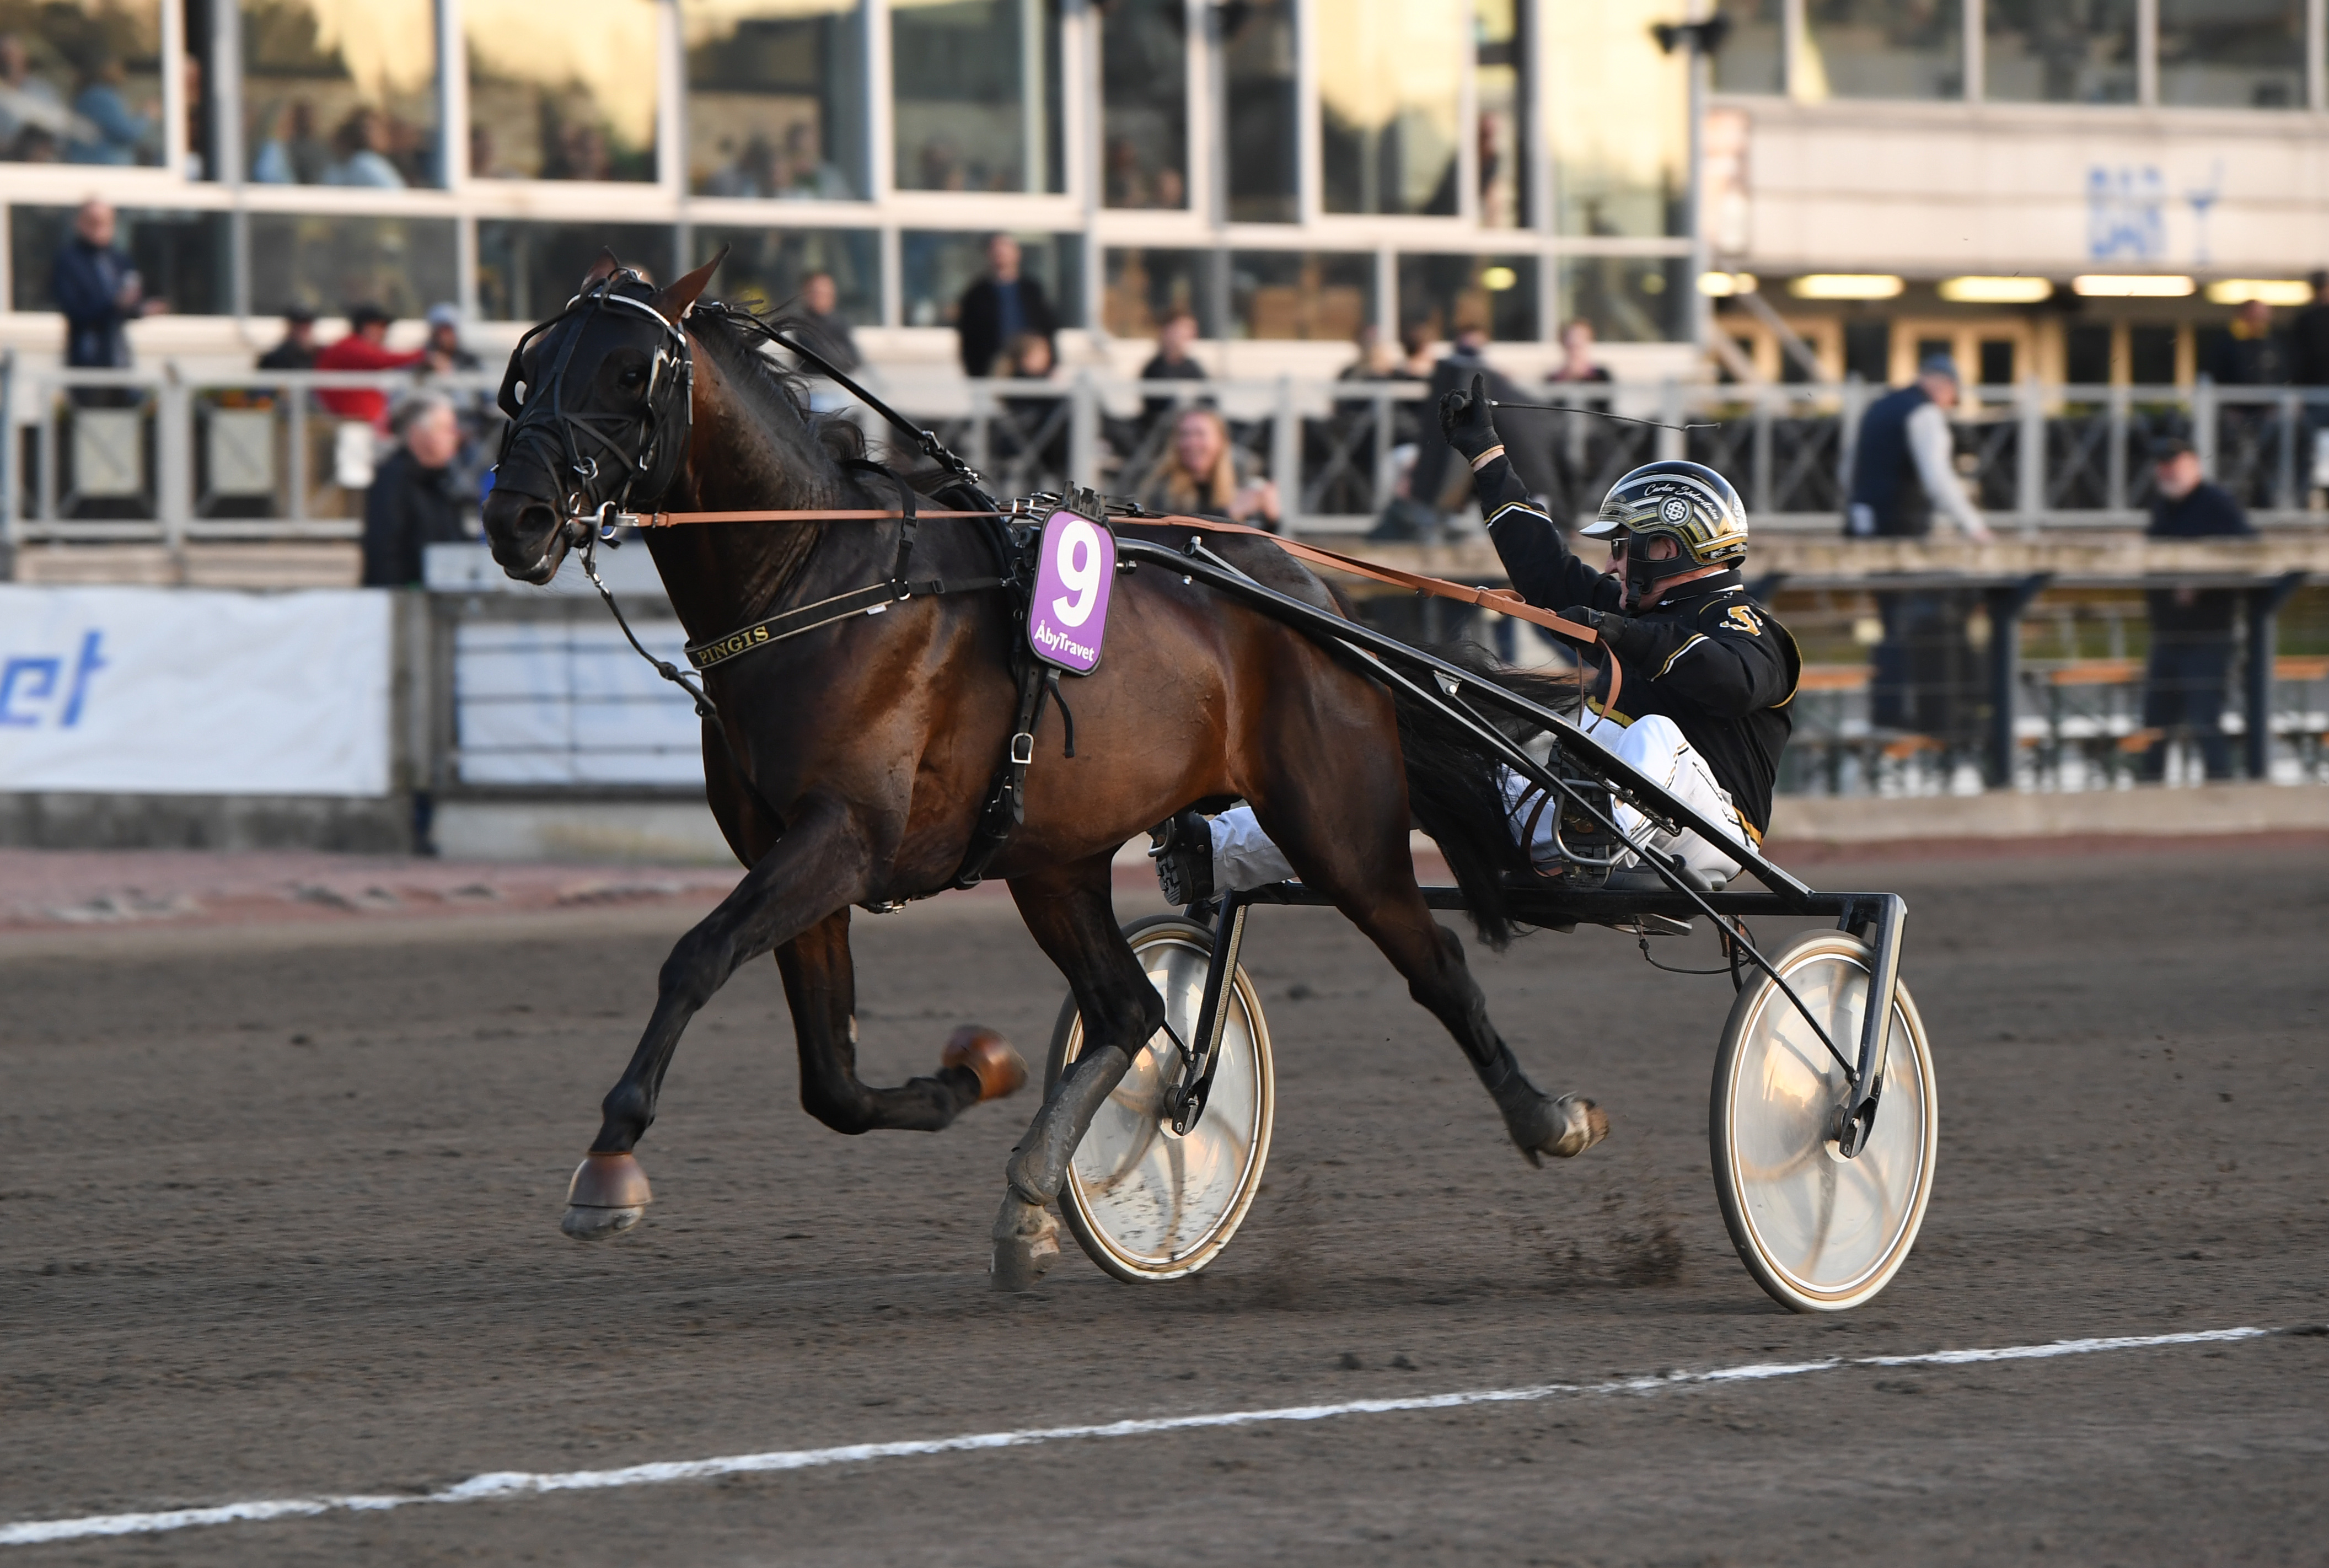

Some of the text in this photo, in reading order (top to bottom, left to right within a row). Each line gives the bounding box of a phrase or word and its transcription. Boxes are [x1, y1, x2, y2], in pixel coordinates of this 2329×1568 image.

[1644, 484, 1676, 496] Carlos
[1675, 486, 1719, 520] Söderström
[1052, 520, 1101, 627] 9
[697, 625, 769, 664] PINGIS
[1034, 619, 1094, 662] ÅbyTravet
